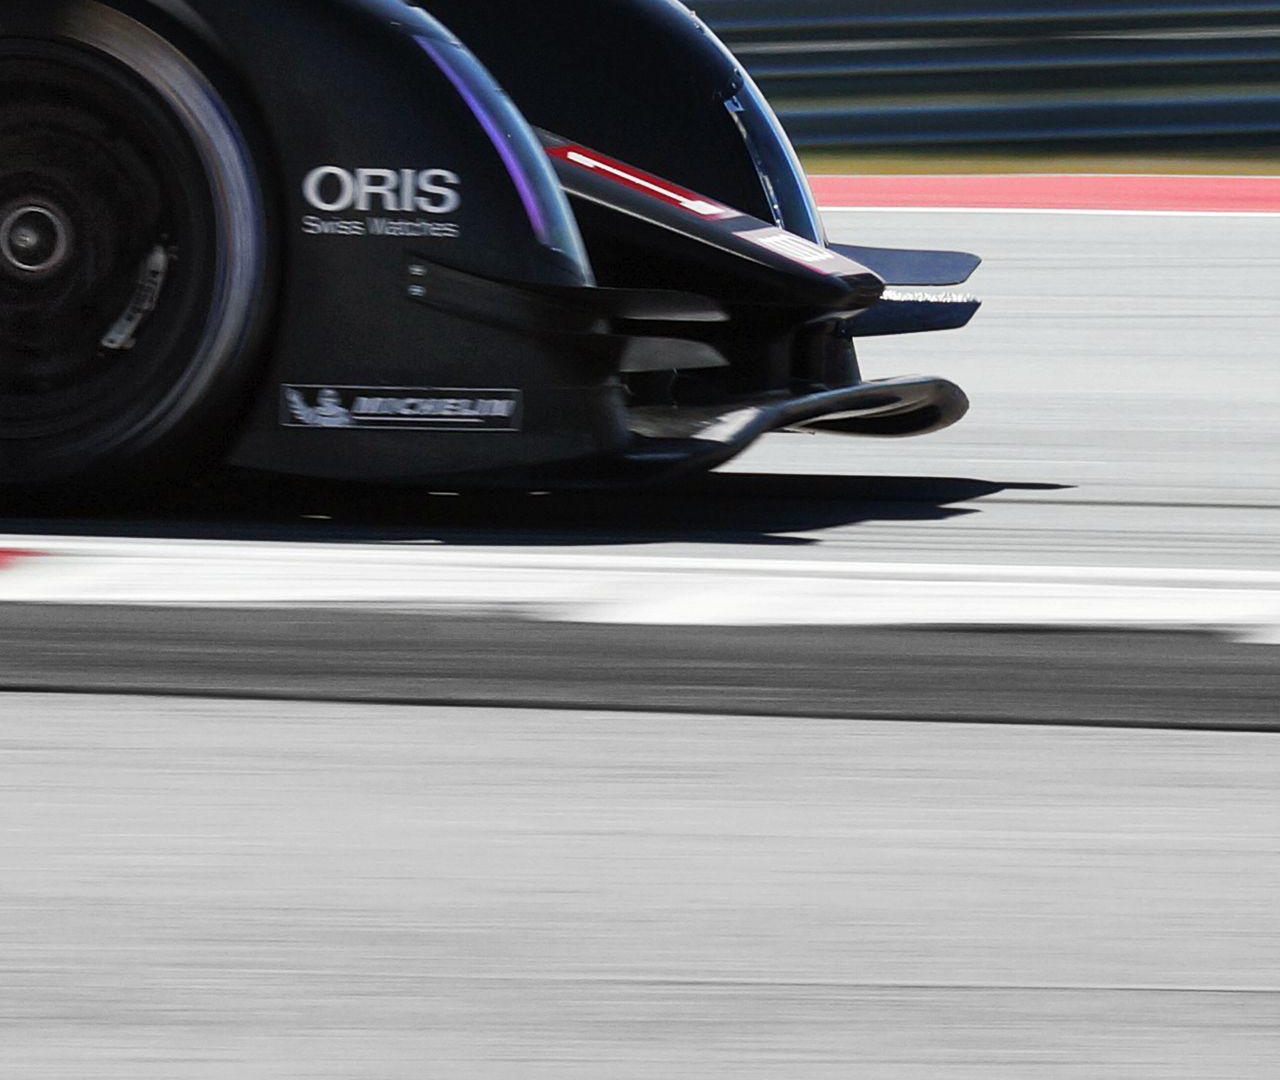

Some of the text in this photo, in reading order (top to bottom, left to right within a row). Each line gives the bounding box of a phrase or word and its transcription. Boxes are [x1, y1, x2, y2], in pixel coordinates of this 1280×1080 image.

[302, 165, 462, 213] ORIS
[301, 215, 460, 238] Swiss Watches
